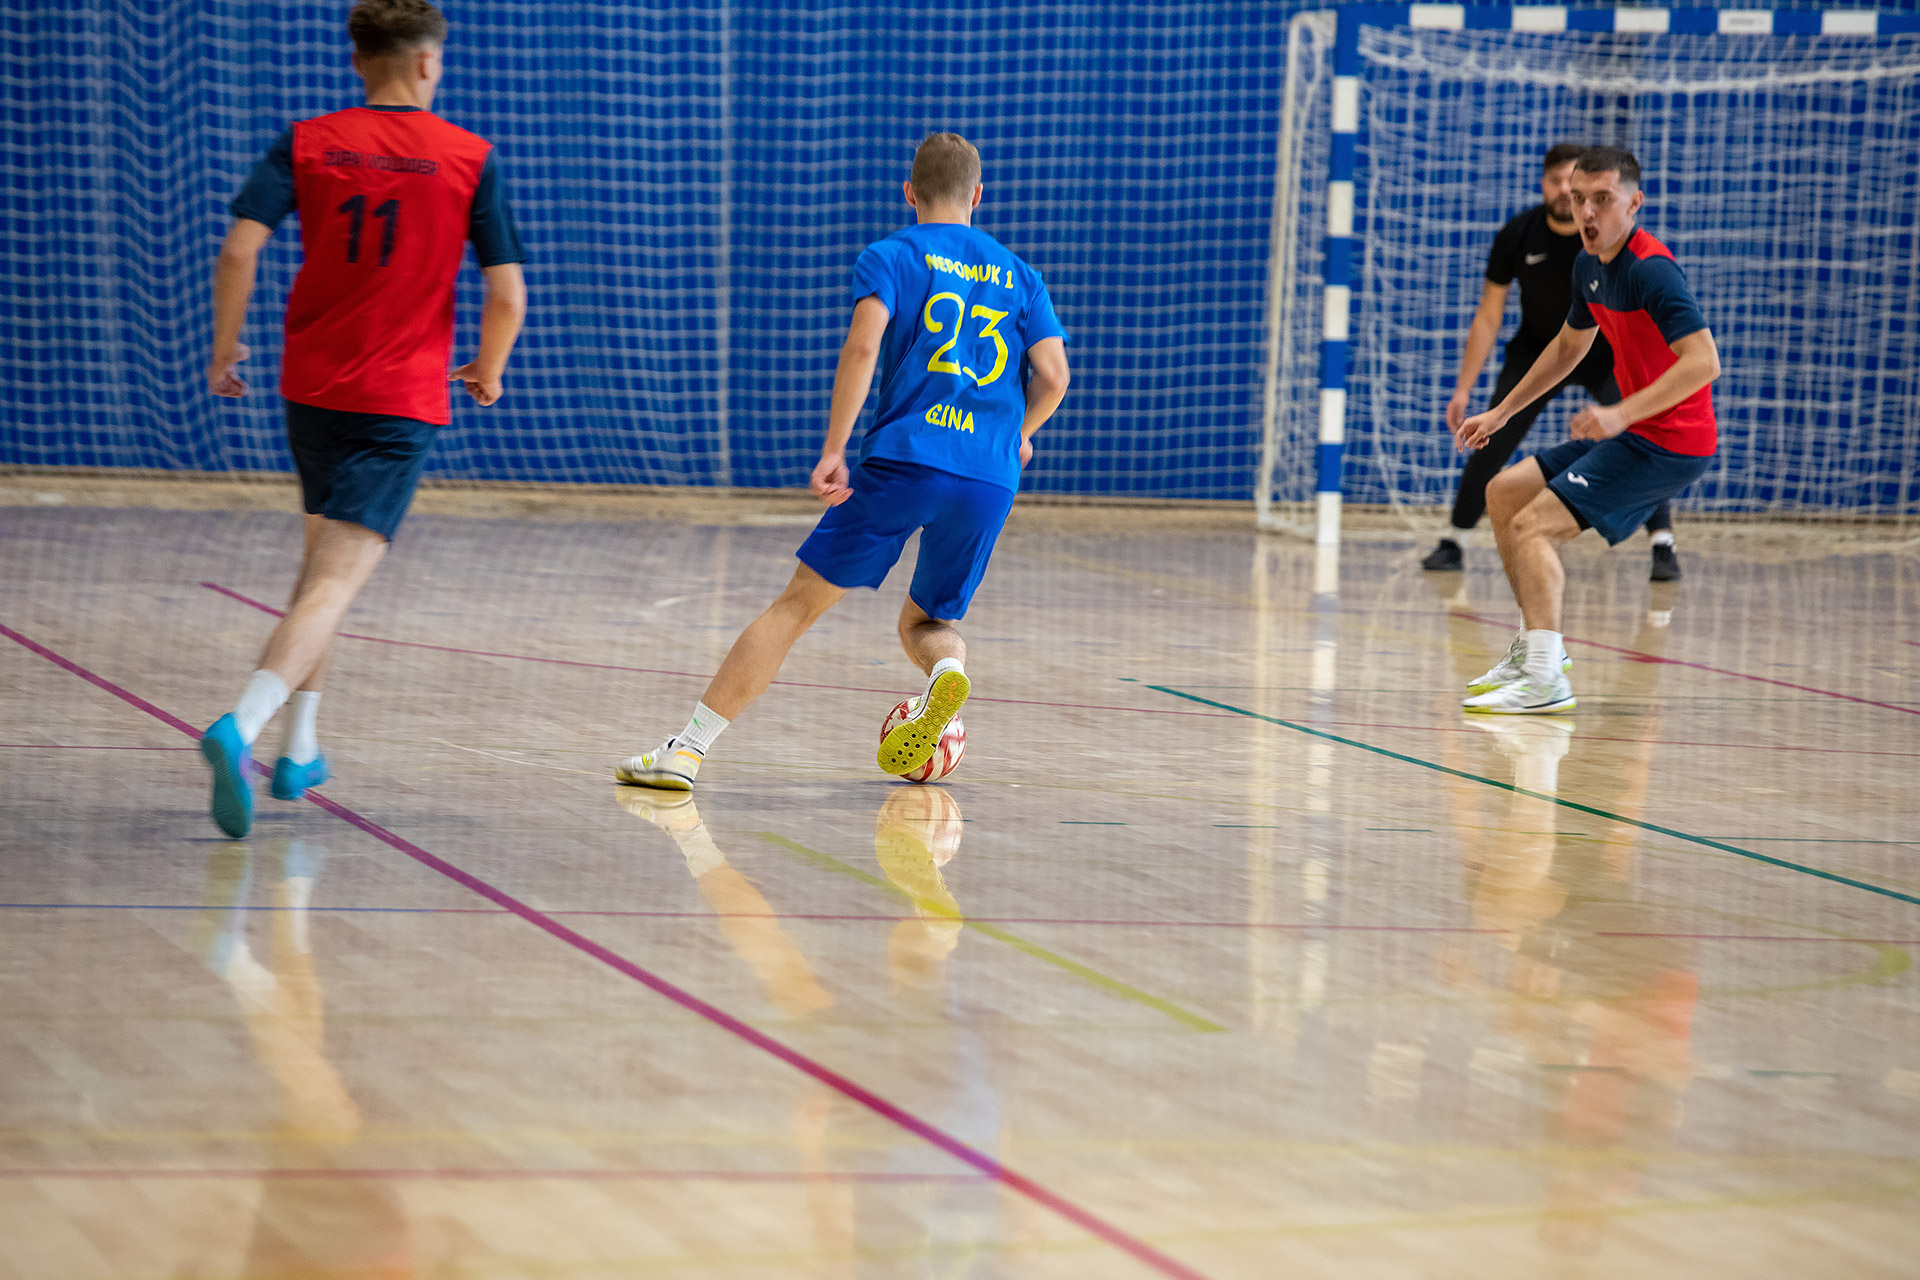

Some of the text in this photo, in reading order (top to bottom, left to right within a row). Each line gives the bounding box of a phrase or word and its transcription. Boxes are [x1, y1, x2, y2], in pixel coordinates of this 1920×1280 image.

[339, 194, 401, 267] 11
[925, 253, 1014, 289] NEPOMUK 1
[924, 292, 1009, 386] 23
[925, 403, 974, 434] GINA
